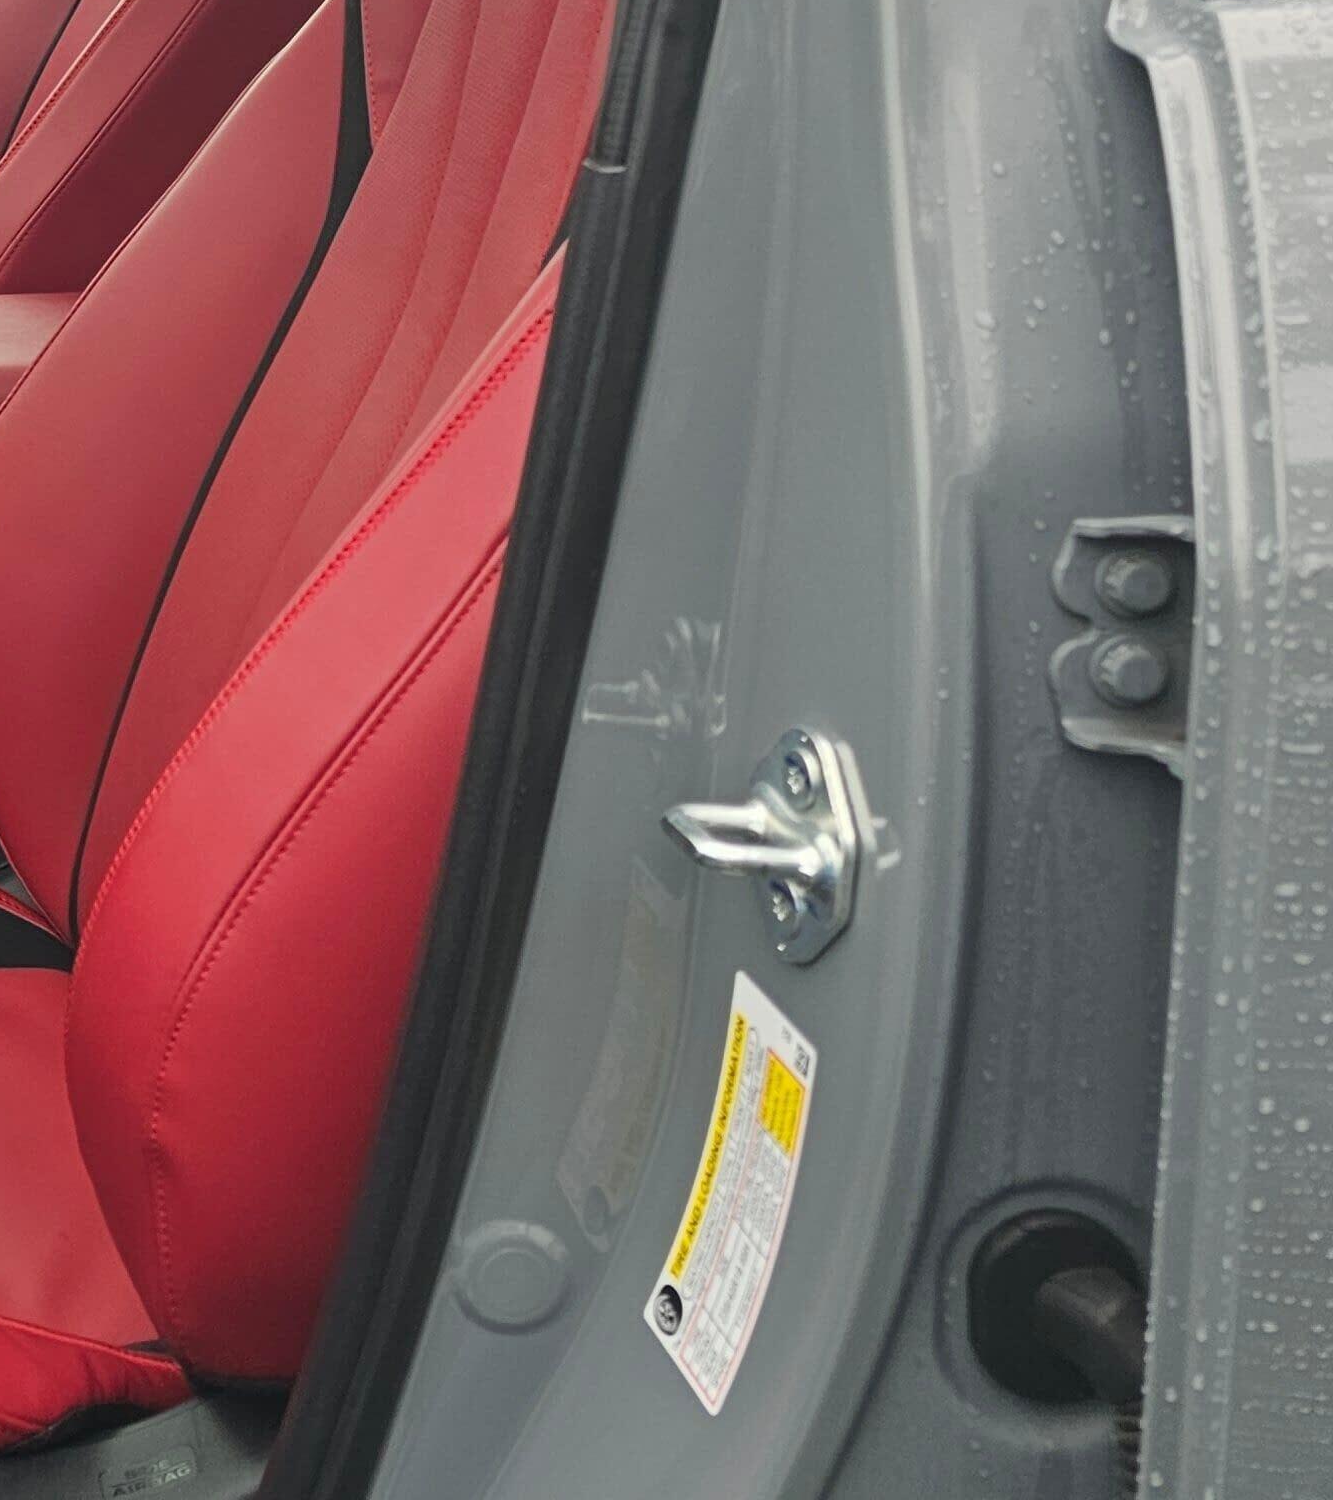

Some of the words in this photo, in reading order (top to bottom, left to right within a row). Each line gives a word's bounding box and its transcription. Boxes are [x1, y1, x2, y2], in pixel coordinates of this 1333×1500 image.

[670, 1243, 689, 1278] TIRE
[685, 1205, 702, 1238] AND
[697, 1132, 724, 1205] LOADING
[717, 1014, 745, 1129] INFORMATION
